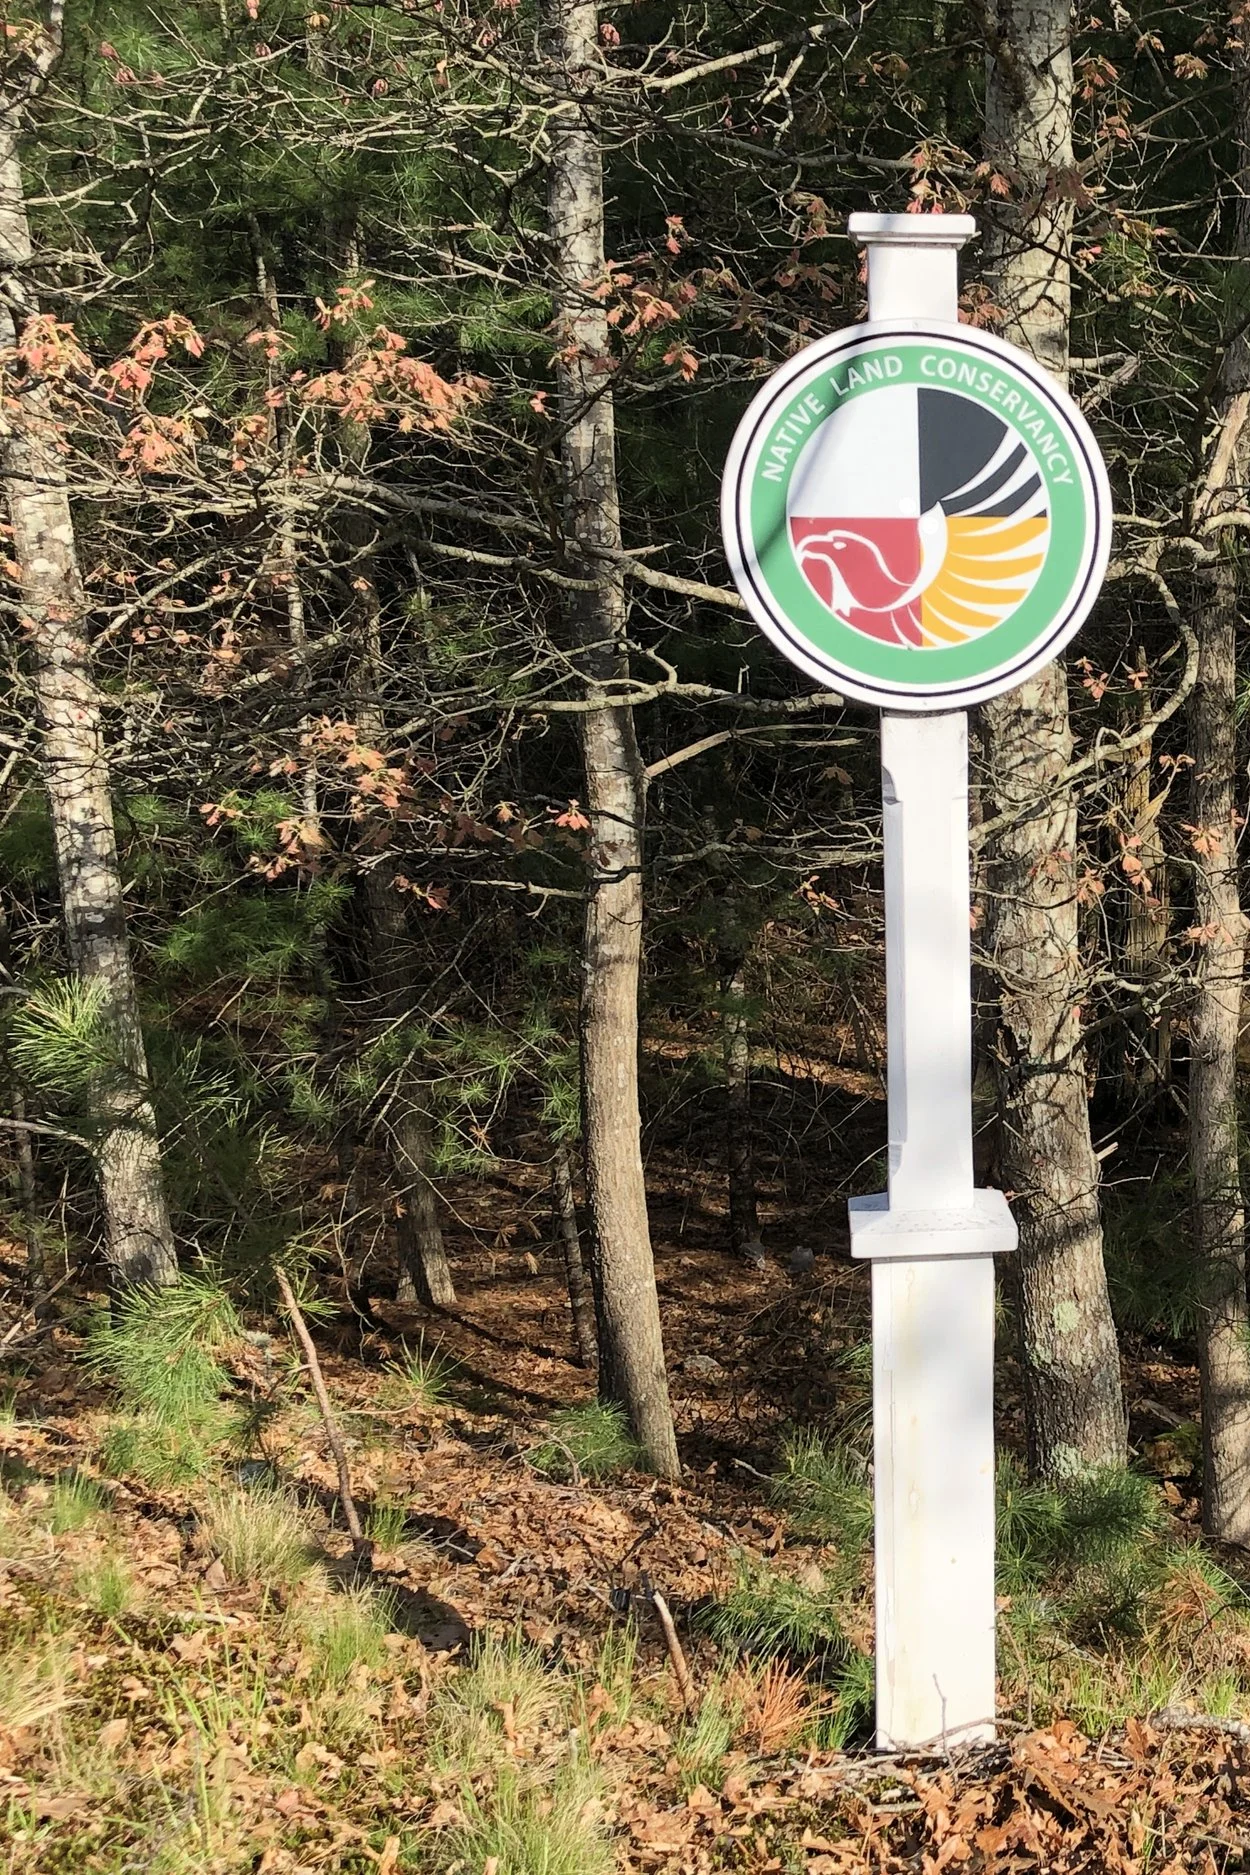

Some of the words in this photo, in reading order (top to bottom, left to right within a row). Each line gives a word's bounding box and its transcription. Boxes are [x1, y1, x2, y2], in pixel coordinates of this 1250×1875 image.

[761, 392, 826, 483] NATIVE
[829, 355, 903, 396] LAND
[920, 354, 1074, 485] CONSERVANCY
